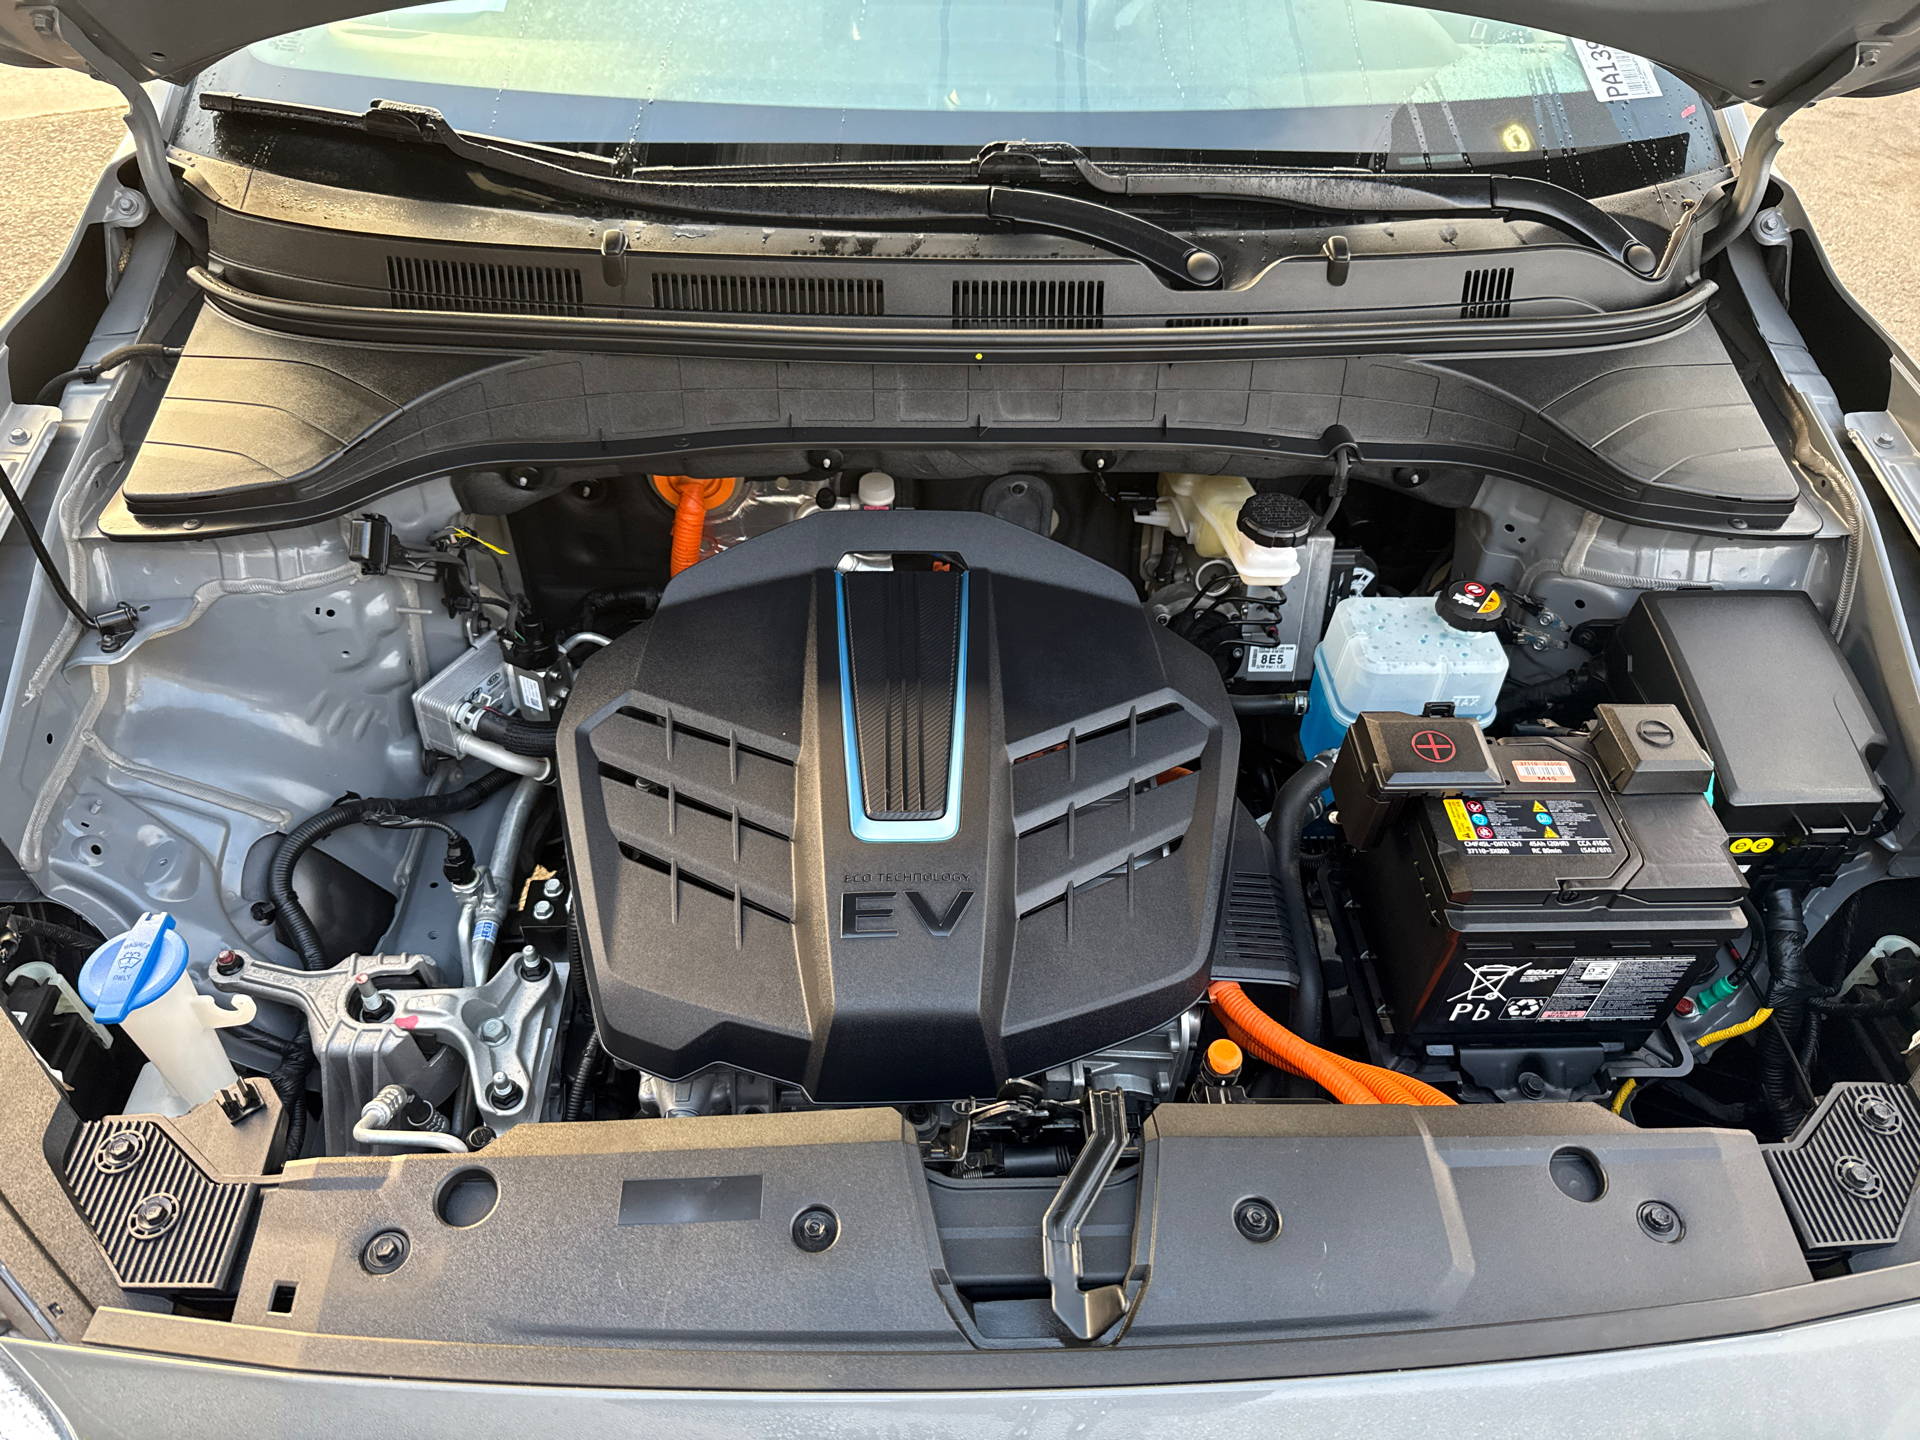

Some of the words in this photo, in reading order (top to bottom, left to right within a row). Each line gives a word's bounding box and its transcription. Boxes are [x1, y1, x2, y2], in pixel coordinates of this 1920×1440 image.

[1260, 654, 1284, 664] 8E5
[844, 873, 873, 883] ECO
[878, 872, 971, 883] TECHNOLOGY
[840, 888, 976, 939] EV
[123, 941, 151, 950] WASHER
[1448, 1003, 1491, 1021] Pb
